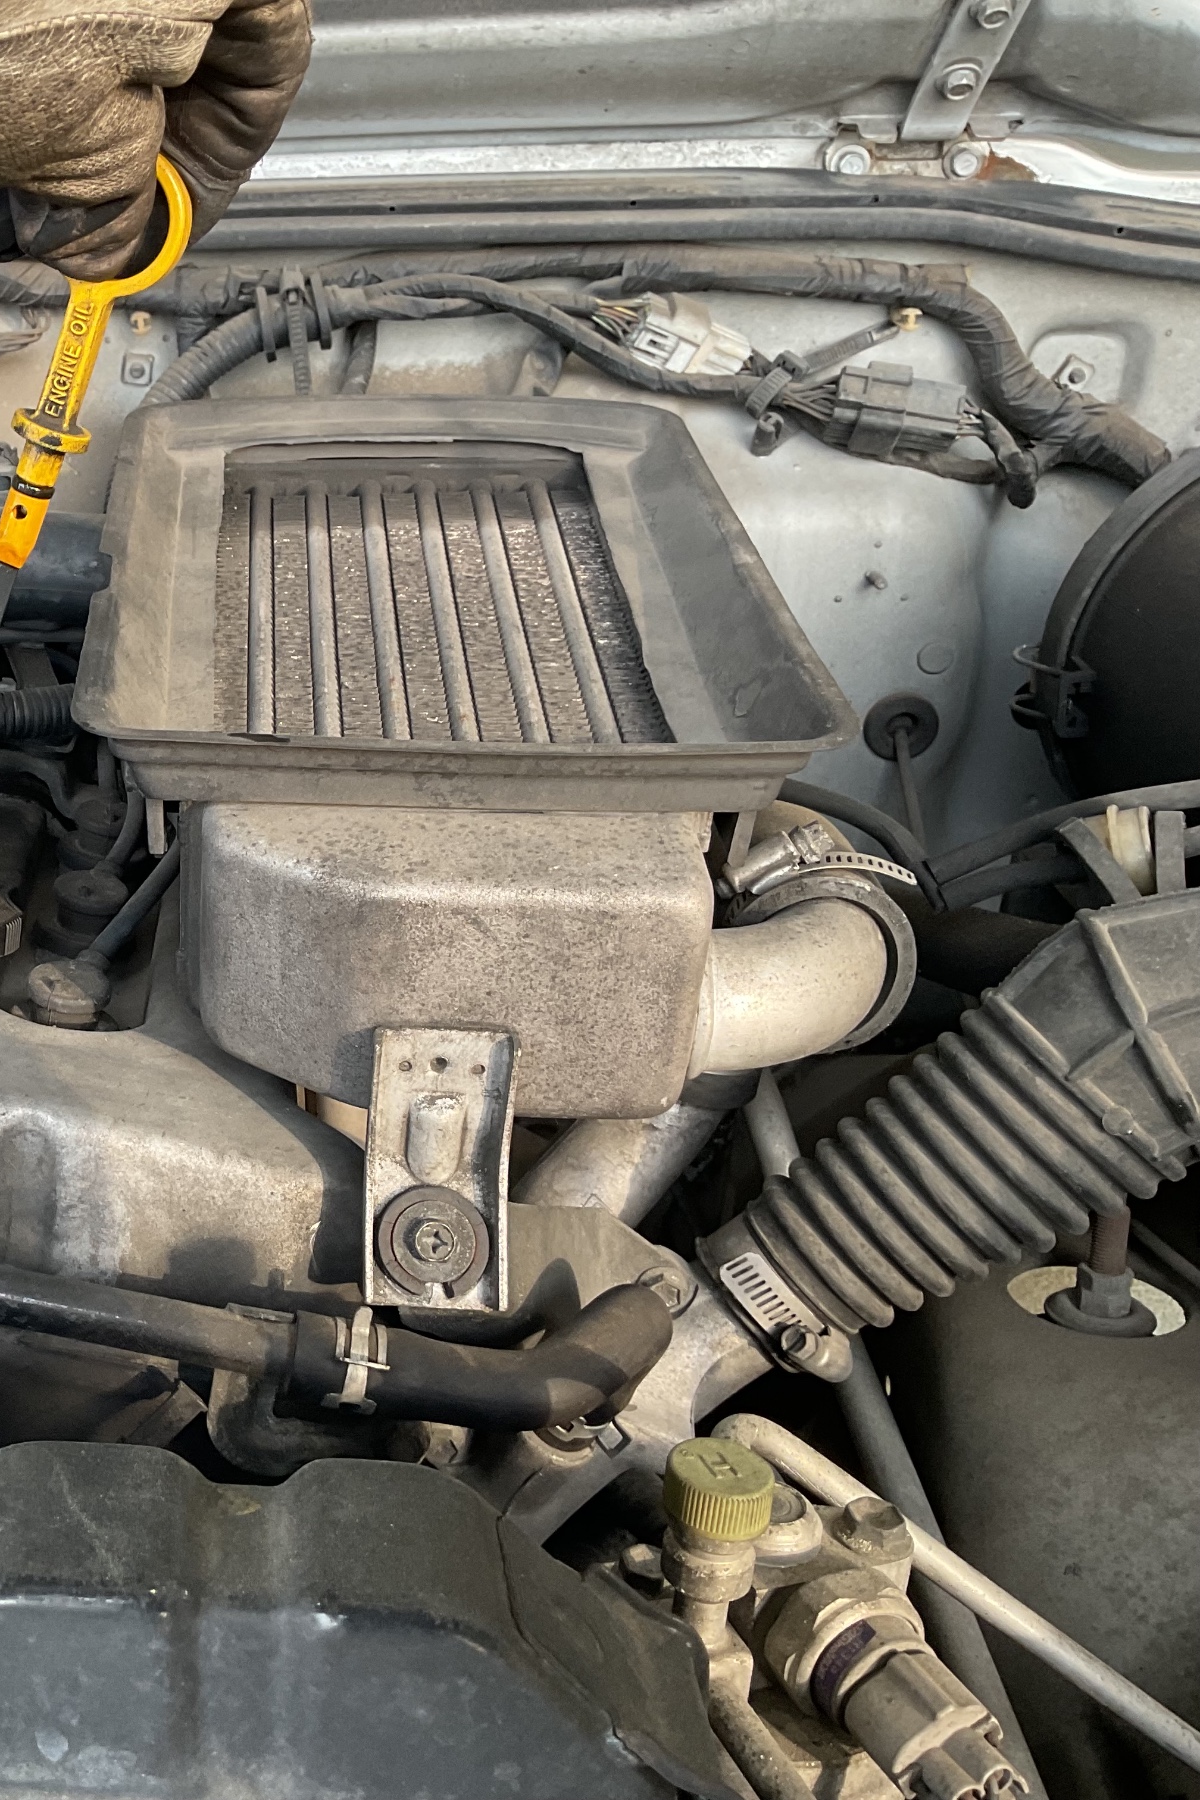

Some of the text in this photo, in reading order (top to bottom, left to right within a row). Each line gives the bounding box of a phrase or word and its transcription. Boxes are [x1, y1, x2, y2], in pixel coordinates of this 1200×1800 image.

[44, 301, 95, 418] ENGINE OIL
[697, 1451, 743, 1479] H
